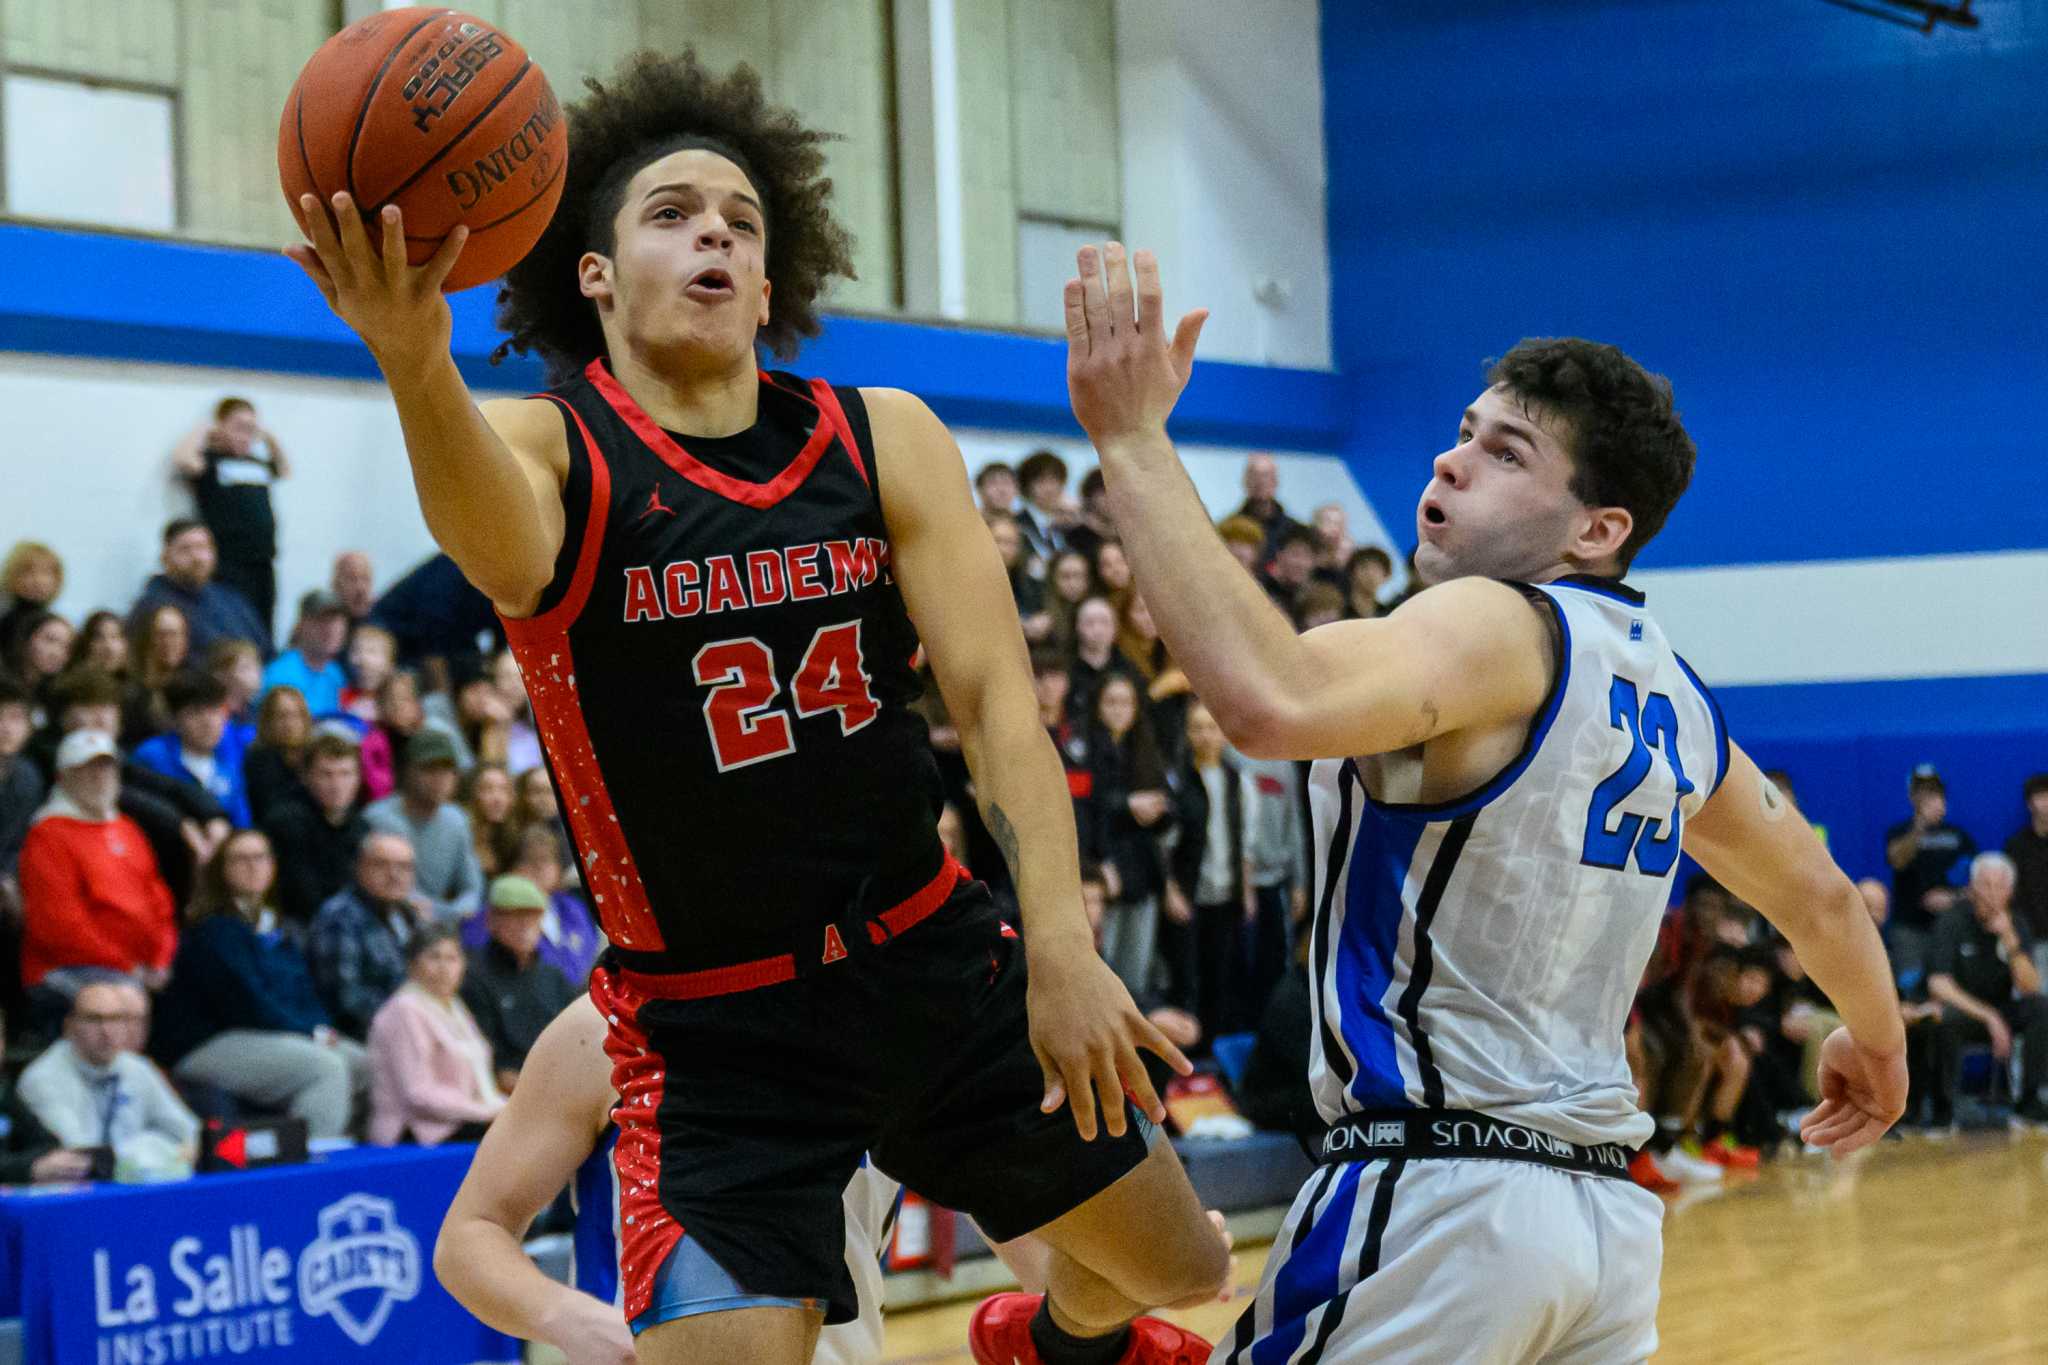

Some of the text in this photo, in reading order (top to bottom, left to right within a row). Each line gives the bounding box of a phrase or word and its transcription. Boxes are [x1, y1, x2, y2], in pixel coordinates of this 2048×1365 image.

[446, 97, 554, 210] ALDING
[691, 618, 882, 774] 24
[1579, 673, 1696, 878] 23
[822, 923, 849, 964] A
[1431, 1120, 1555, 1157] NOVUS
[93, 1223, 293, 1328] La Salle
[97, 1307, 295, 1365] INSTITUTE
